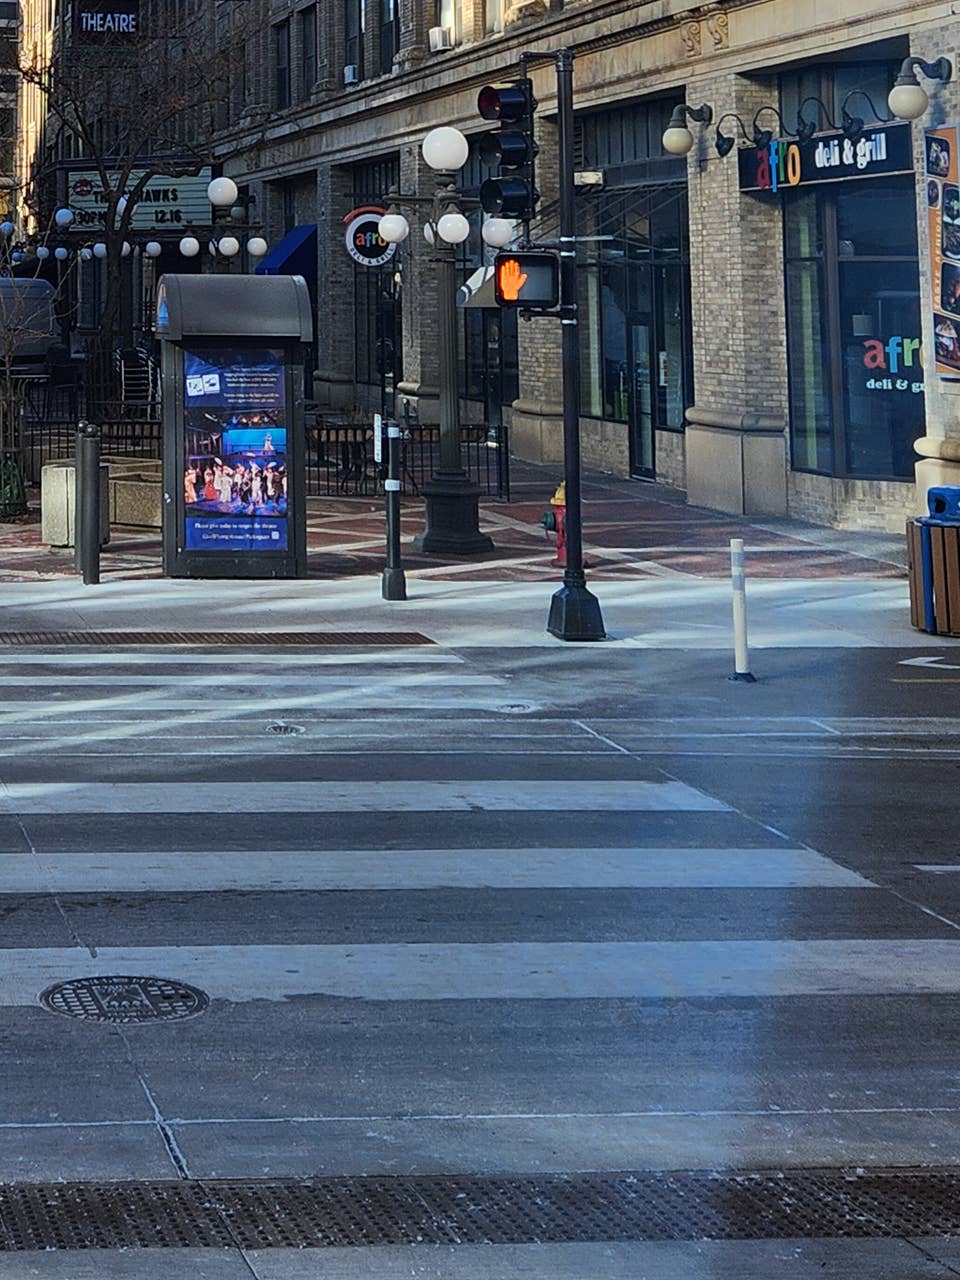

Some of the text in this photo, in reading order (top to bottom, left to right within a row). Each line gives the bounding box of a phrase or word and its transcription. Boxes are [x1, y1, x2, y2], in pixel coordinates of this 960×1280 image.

[81, 13, 136, 32] THEATRE
[756, 132, 887, 193] afro deli & grill
[356, 231, 387, 247] afro
[863, 336, 924, 373] afr
[866, 379, 893, 390] deli
[895, 379, 908, 390] &
